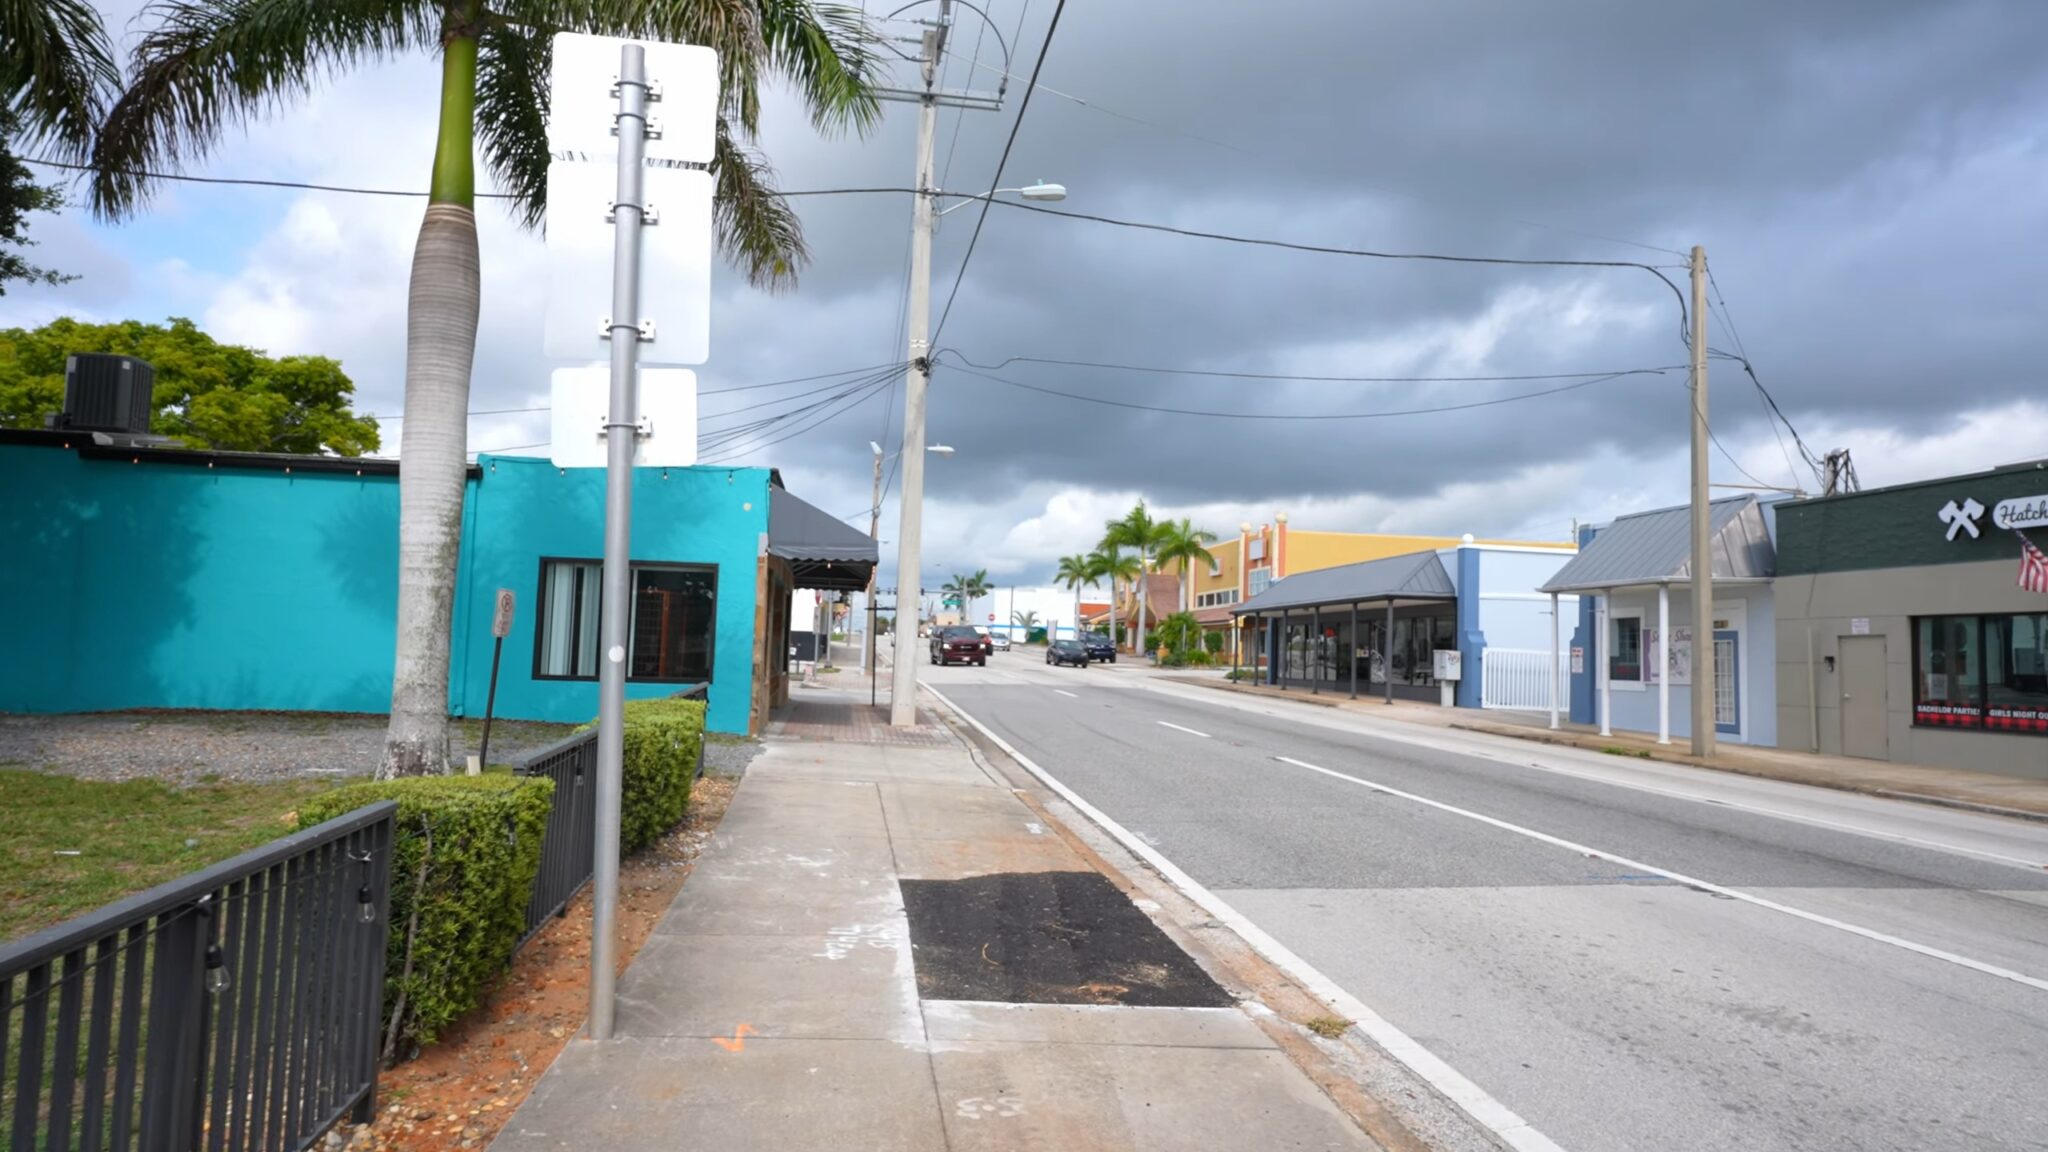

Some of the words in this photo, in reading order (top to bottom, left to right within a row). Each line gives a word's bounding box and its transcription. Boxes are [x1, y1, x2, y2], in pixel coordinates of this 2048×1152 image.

[1917, 704, 1952, 714] BACHELOR
[1989, 708, 2012, 718] GIRLS
[2013, 710, 2037, 720] NIGHT
